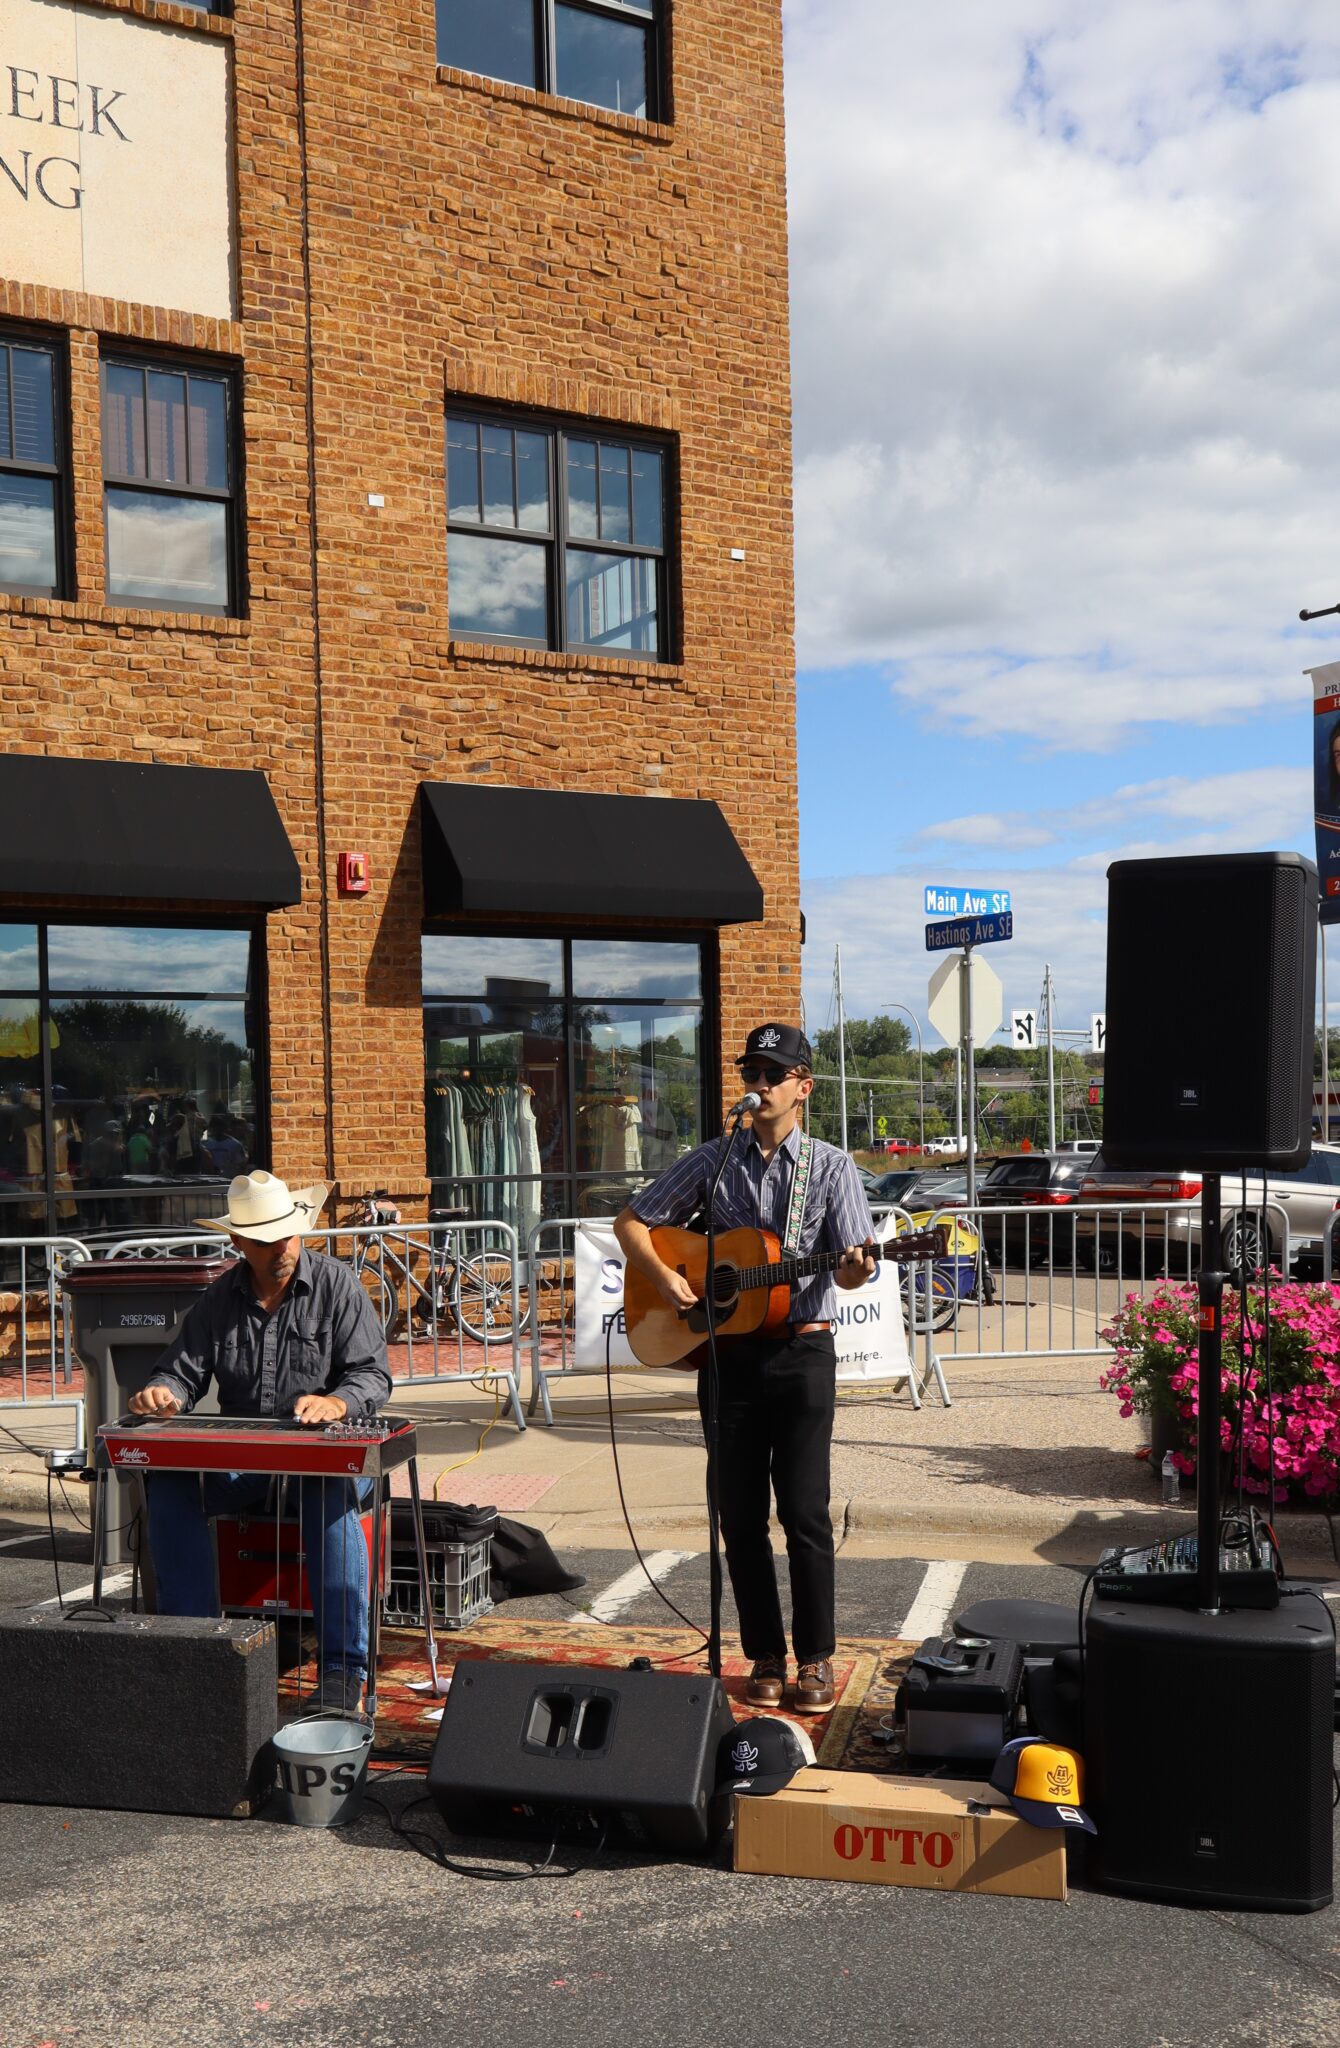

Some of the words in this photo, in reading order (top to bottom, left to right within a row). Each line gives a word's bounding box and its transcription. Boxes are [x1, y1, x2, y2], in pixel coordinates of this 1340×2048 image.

[0, 65, 132, 143] EEK
[1325, 683, 1340, 695] PR
[926, 890, 957, 912] Main
[963, 892, 987, 913] Ave
[927, 925, 971, 947] Hastings
[974, 920, 994, 940] Ave
[998, 915, 1012, 937] SE
[1184, 1090, 1197, 1098] JBL
[114, 1447, 148, 1459] Mullen
[1200, 1837, 1215, 1847] JBL
